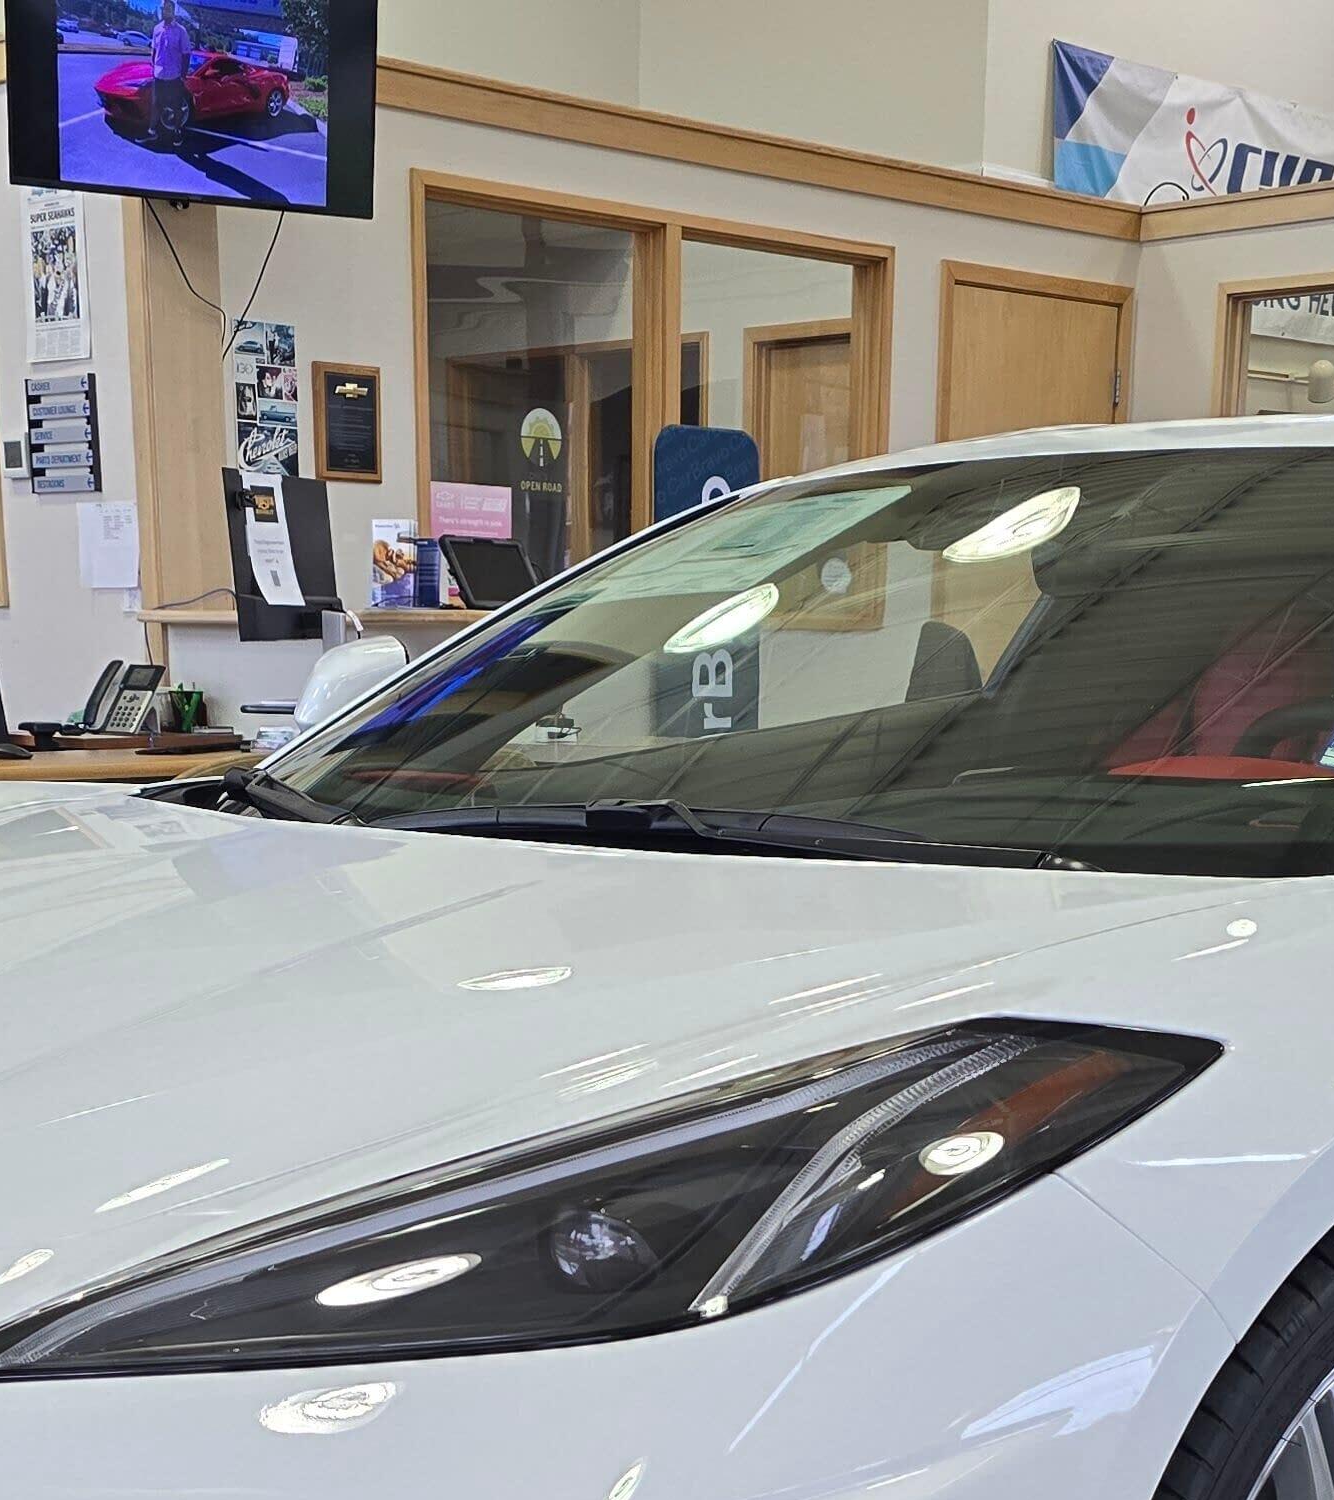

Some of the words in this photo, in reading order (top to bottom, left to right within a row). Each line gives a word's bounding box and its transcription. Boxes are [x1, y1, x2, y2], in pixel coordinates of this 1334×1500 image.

[30, 213, 47, 224] SUPER
[48, 207, 75, 221] SEAHAWKS
[31, 382, 50, 392] CASHIER
[32, 406, 57, 416] CUSTOMER
[57, 404, 77, 415] LOUNGE
[34, 430, 53, 441] SERVICE
[36, 454, 51, 465] PARTS
[51, 454, 81, 464] DEPARTMENT
[37, 479, 65, 489] RESTROOMS
[520, 481, 541, 492] OPEN
[542, 482, 562, 492] ROAD
